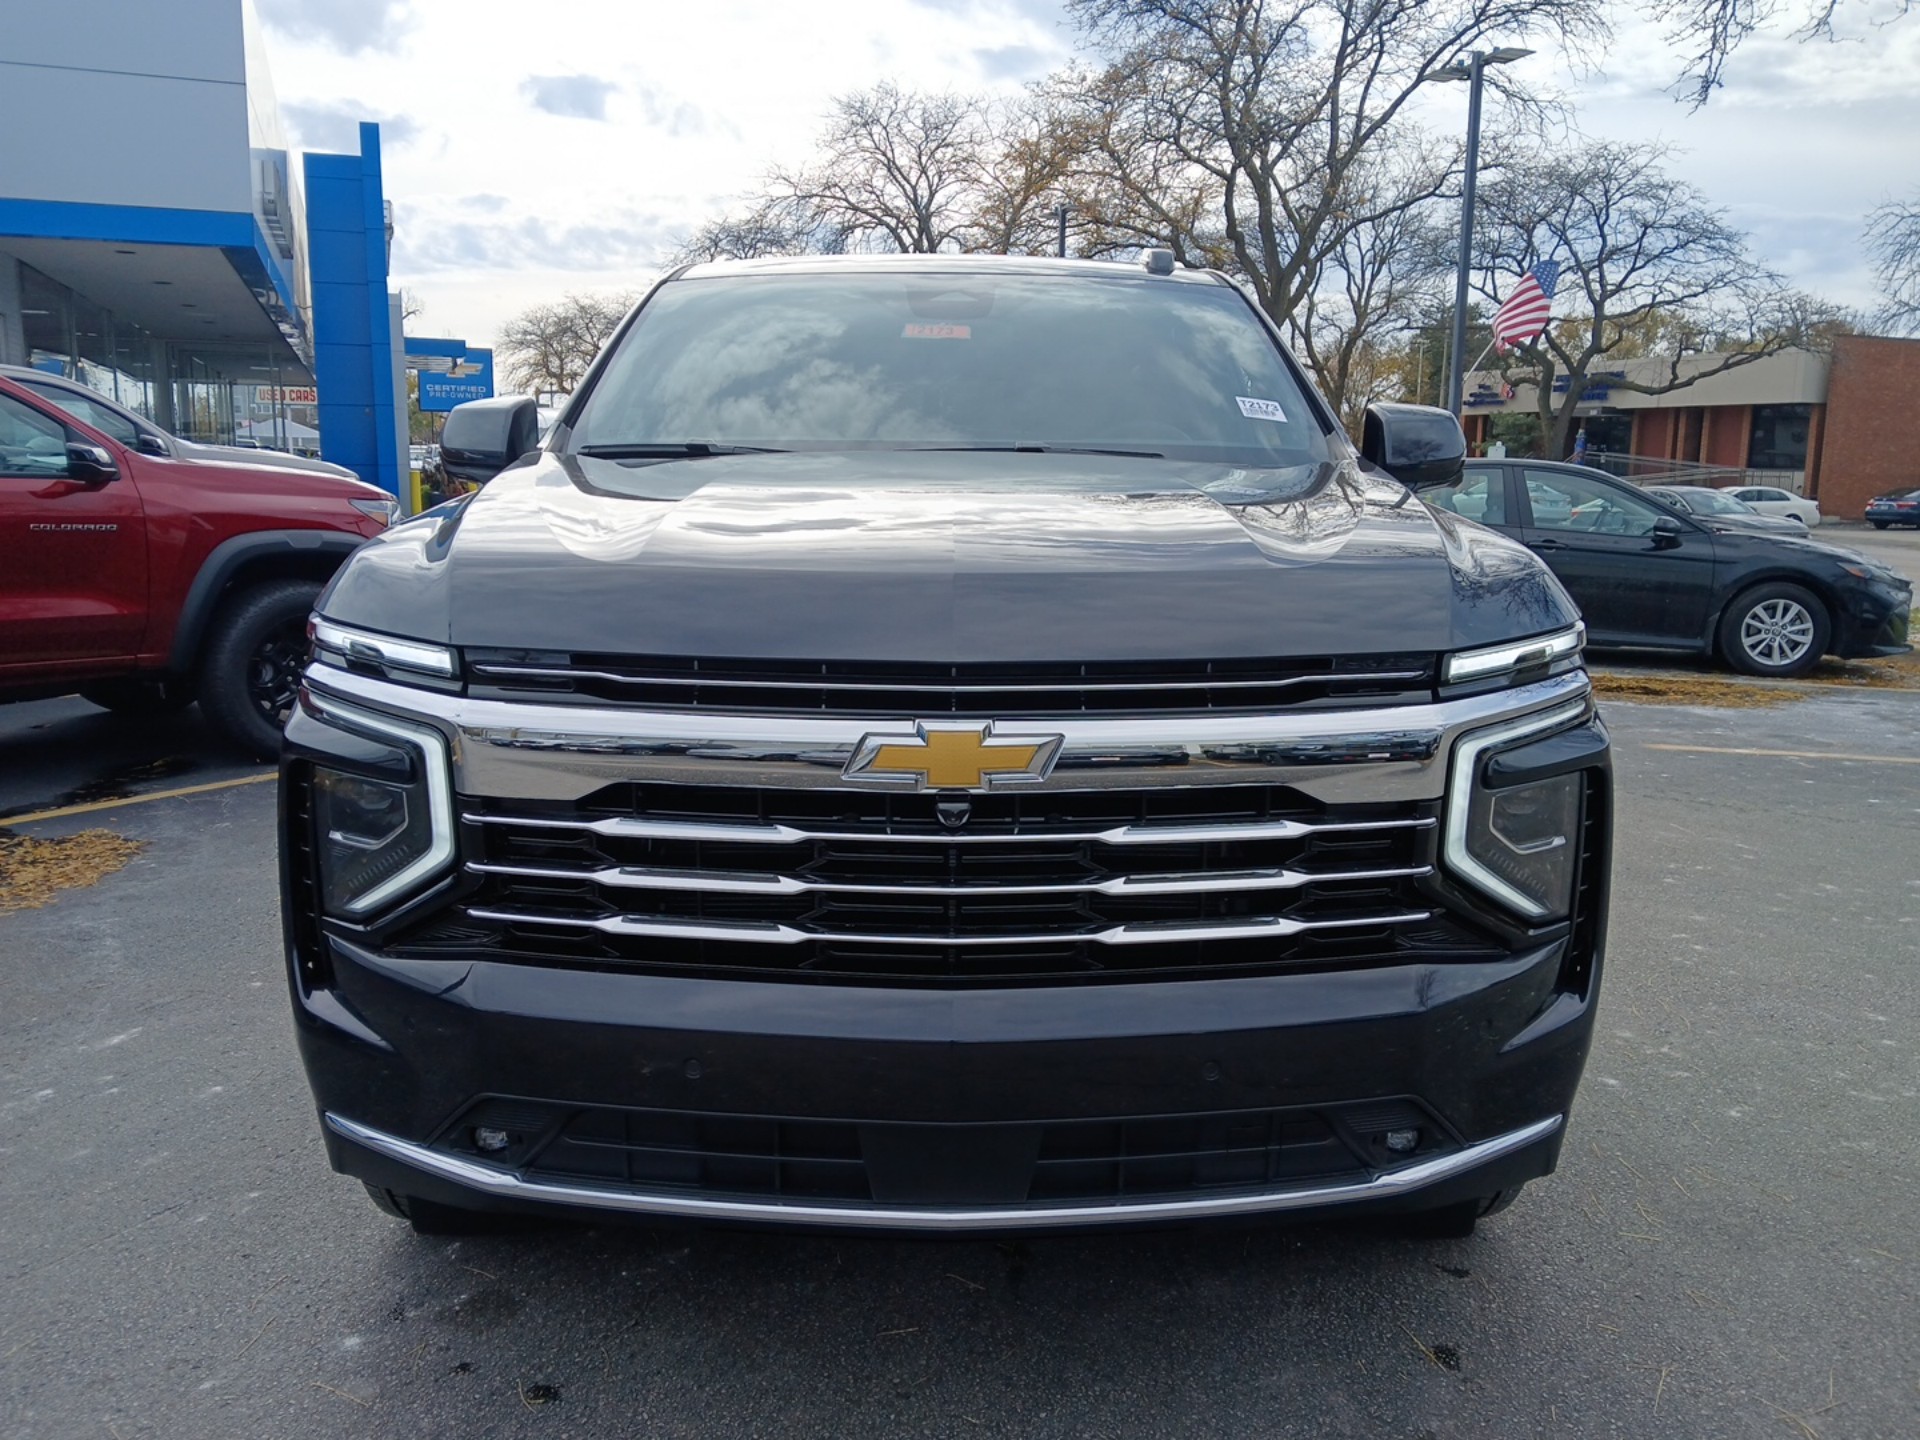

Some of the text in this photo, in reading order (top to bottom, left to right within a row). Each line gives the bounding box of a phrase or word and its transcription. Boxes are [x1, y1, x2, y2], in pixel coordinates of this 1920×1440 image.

[426, 384, 486, 393] CERTIFIED
[259, 388, 317, 402] USED CARS
[429, 391, 484, 399] PRE-OWNED
[29, 523, 118, 531] COLORADO
